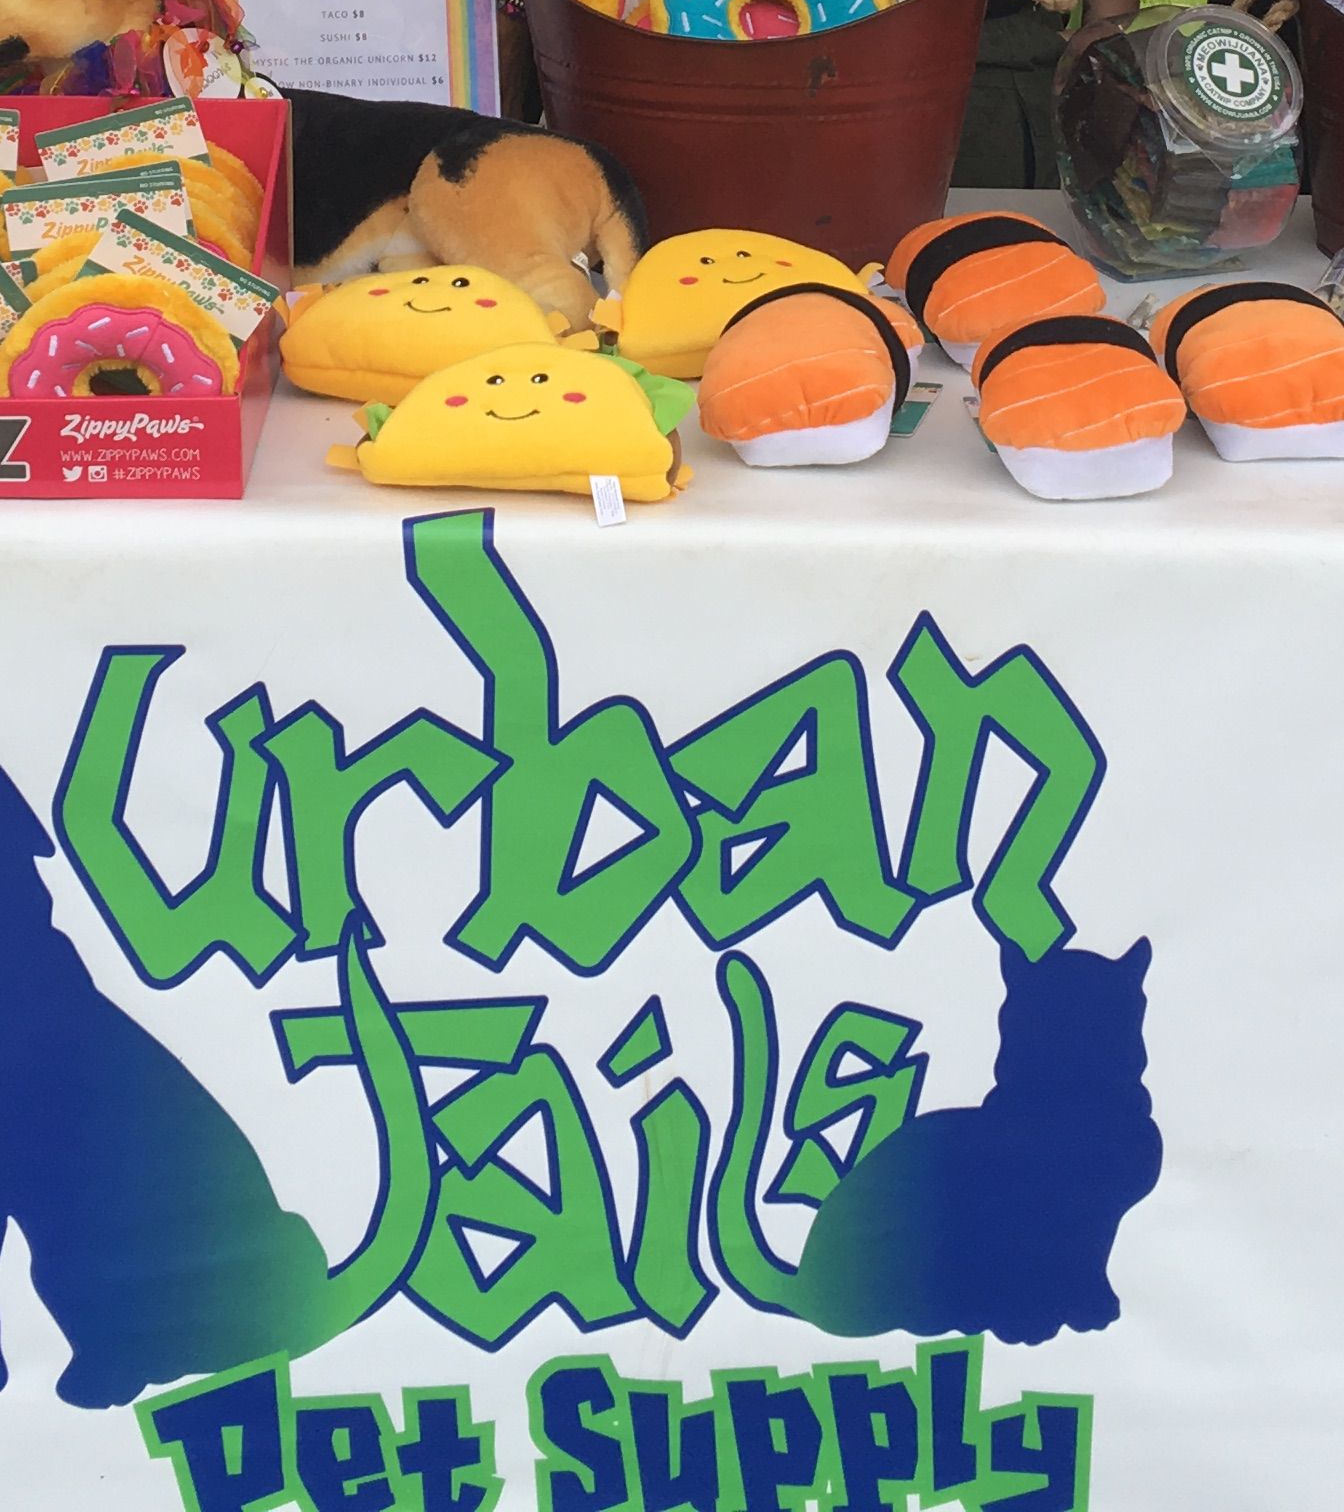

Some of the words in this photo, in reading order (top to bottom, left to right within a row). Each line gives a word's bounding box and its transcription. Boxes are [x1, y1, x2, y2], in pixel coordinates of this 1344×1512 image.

[320, 10, 349, 20] TACO
[352, 9, 366, 20] $8
[319, 33, 352, 43] SUSHI
[355, 32, 368, 42] $8
[293, 57, 314, 67] THE
[317, 55, 364, 67] ORGANIC
[367, 54, 415, 65] UNICORN
[418, 53, 438, 63] $12
[1197, 38, 1269, 76] MEOWIJUANA
[298, 78, 364, 90] NON-BINARY
[367, 77, 428, 88] INDIVIDUAL
[431, 76, 445, 86] $6
[1204, 82, 1233, 104] CATNIP
[1233, 87, 1268, 108] COMPANY
[60, 447, 201, 462] WWW.ZIPPYPAWS.COM
[112, 466, 201, 481] #ZIPPYPAWS
[132, 1348, 506, 1512] Pet
[526, 1334, 1094, 1512] Supply
